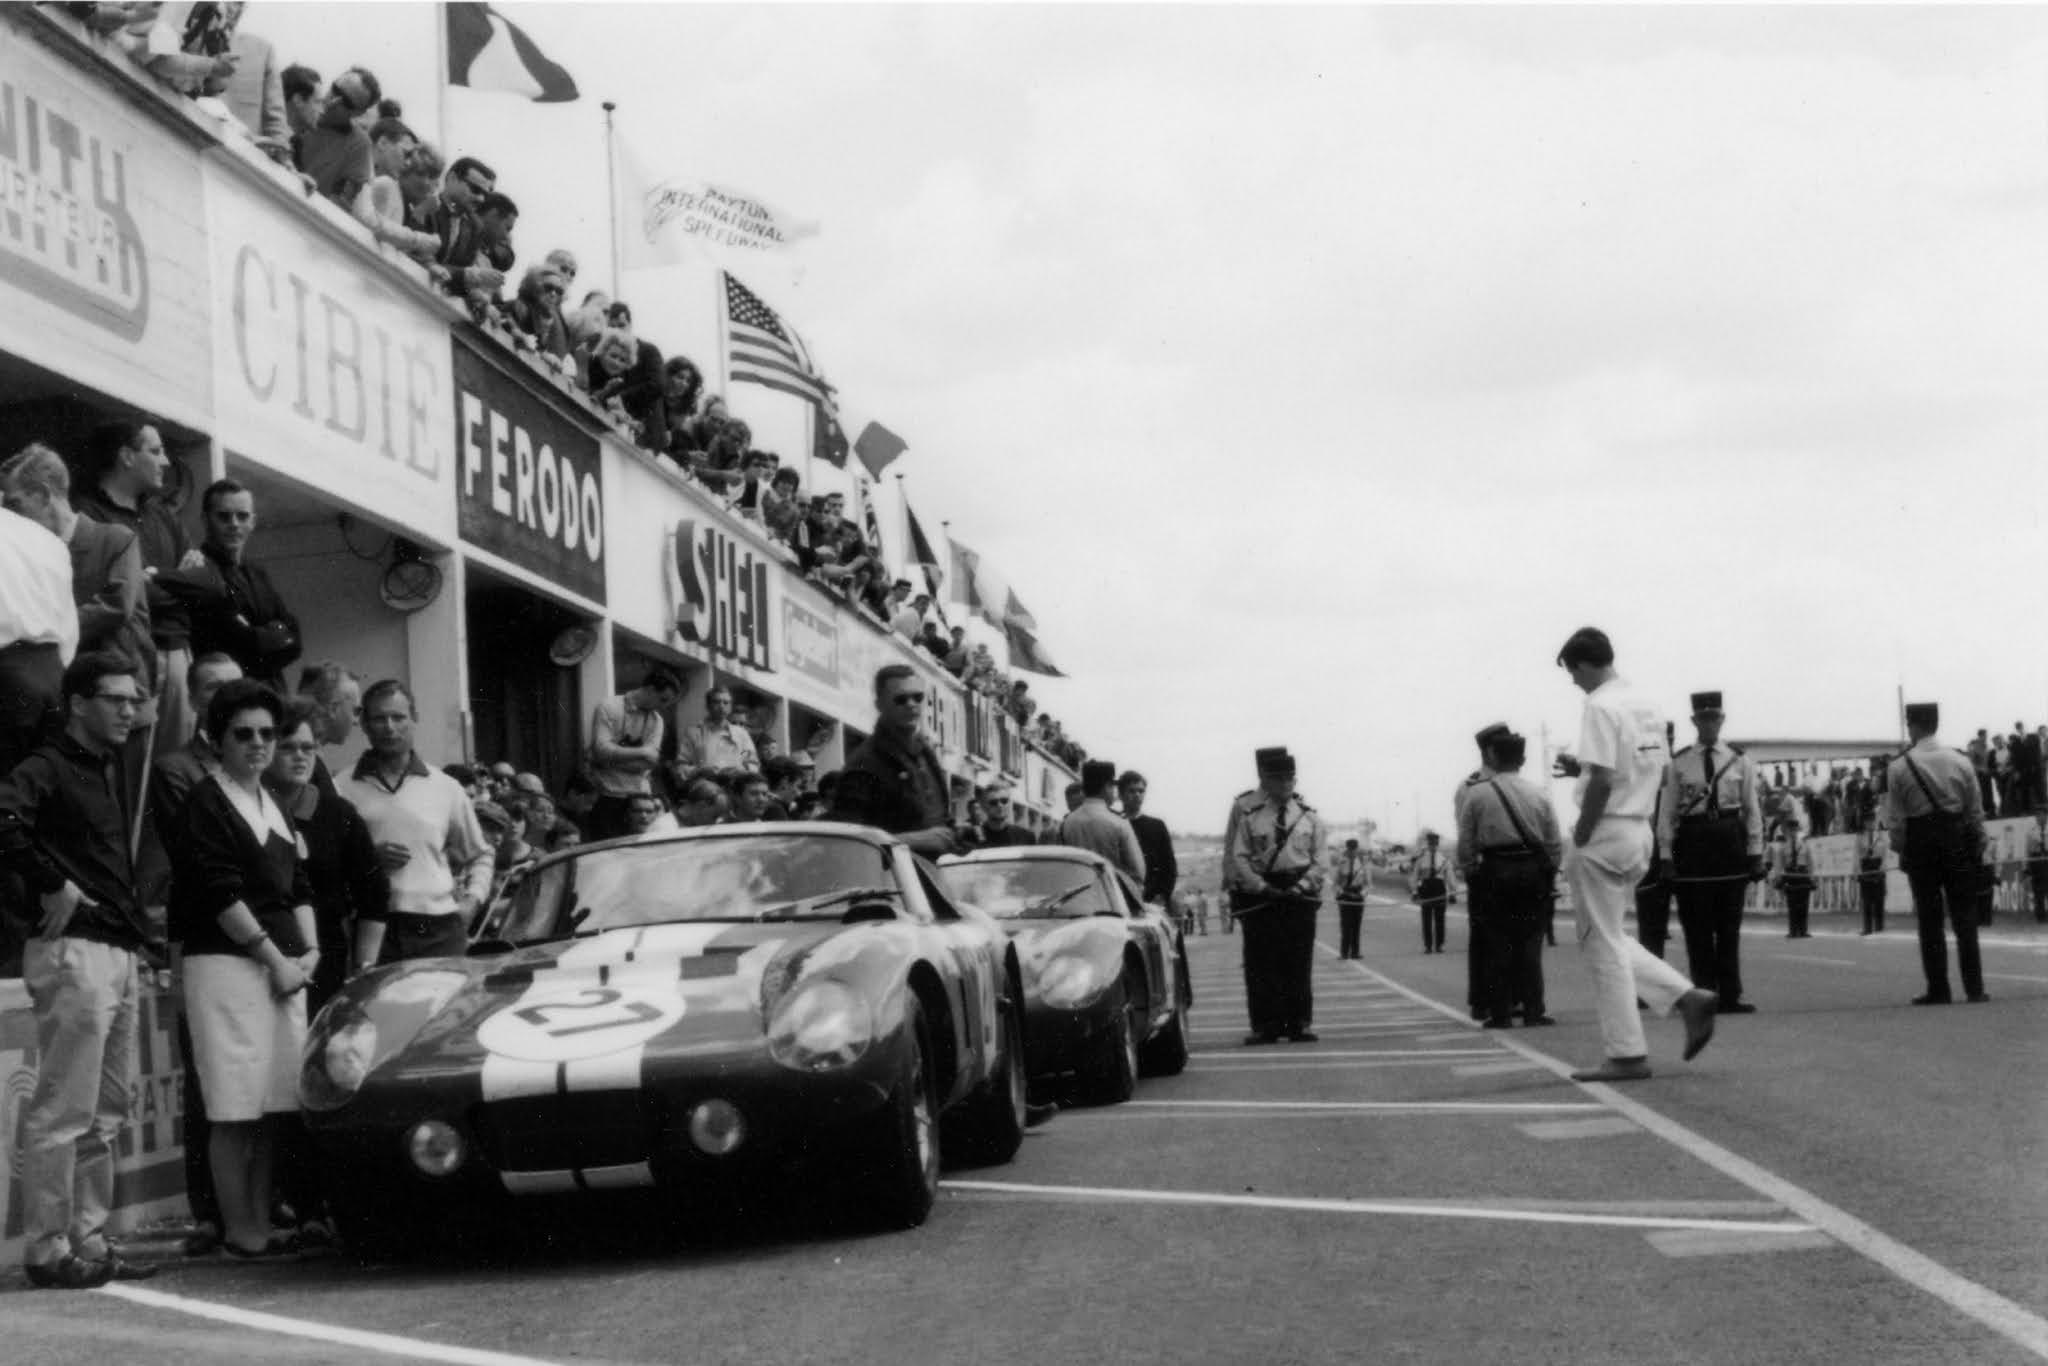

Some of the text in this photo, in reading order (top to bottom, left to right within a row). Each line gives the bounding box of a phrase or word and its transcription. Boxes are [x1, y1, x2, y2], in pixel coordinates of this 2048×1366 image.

[704, 187, 774, 222] DAYTON
[232, 243, 439, 482] CIBIE
[462, 391, 602, 563] FERODO
